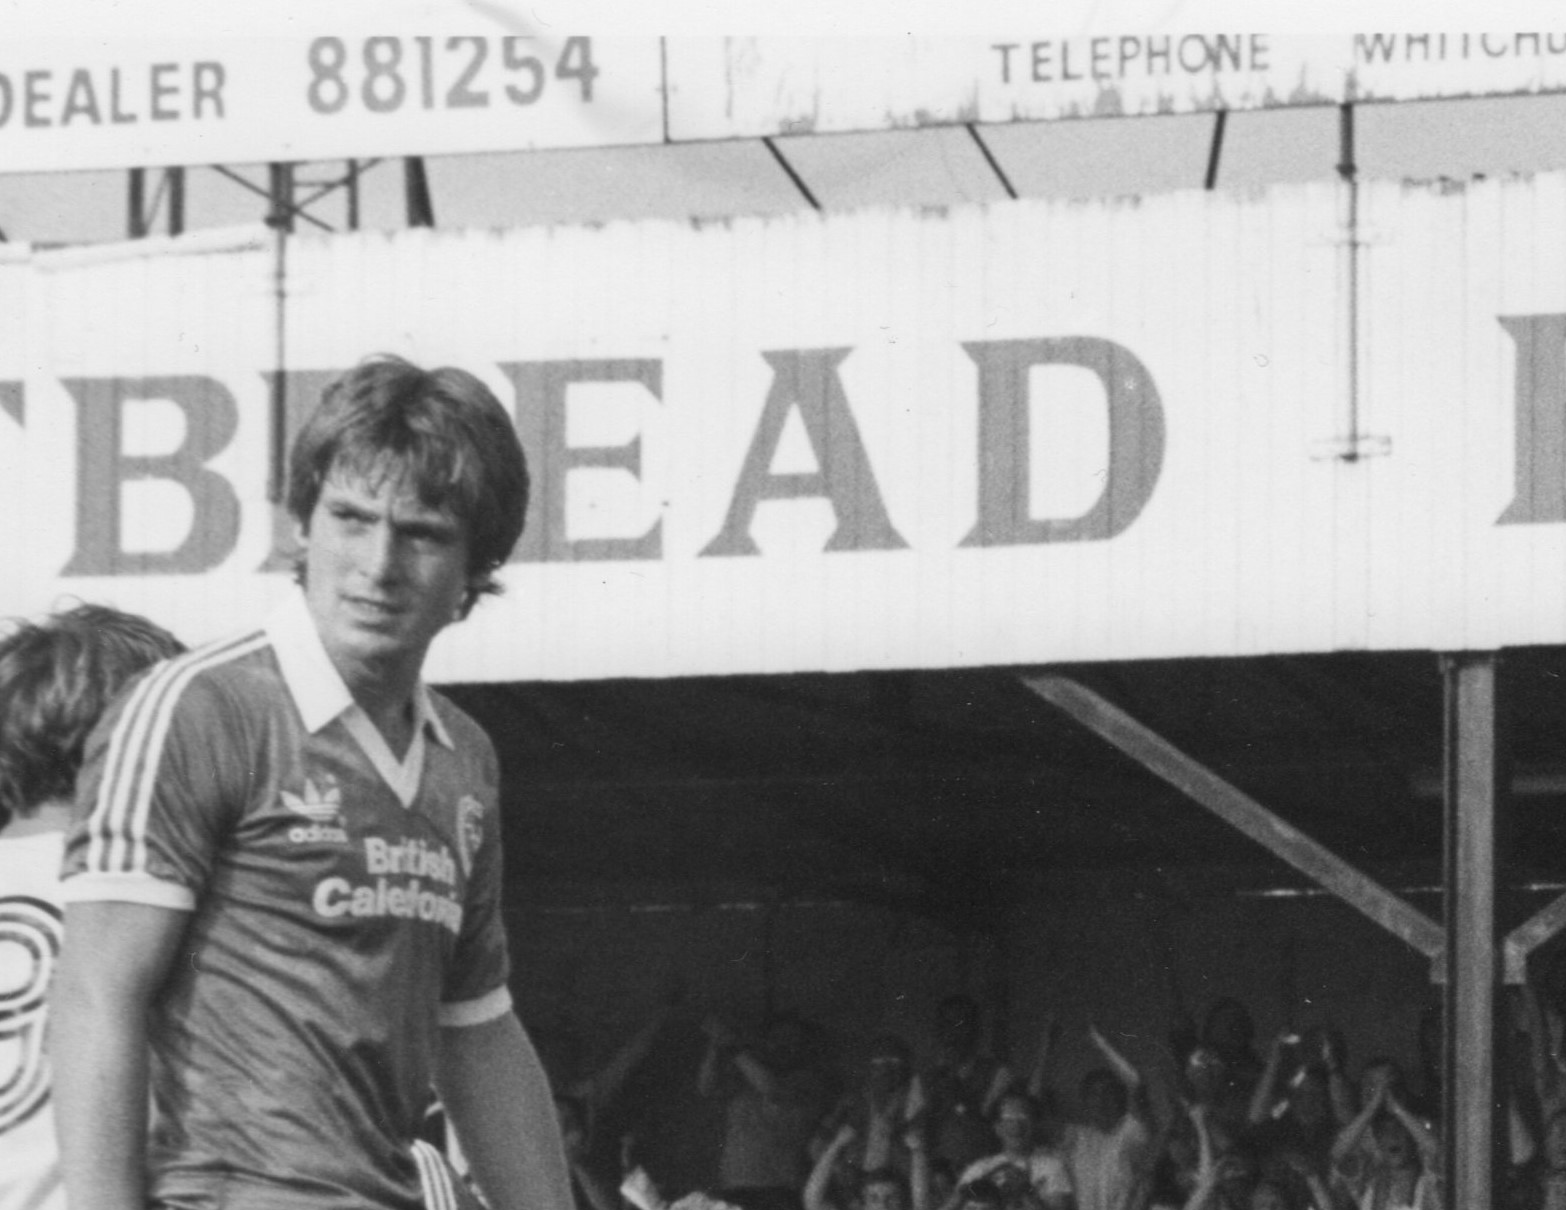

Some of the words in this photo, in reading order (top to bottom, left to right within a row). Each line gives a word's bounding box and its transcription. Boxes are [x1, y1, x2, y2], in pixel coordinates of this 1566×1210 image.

[307, 35, 599, 115] 881254
[991, 33, 1271, 84] TELEPHONE
[0, 336, 1166, 577] BEAD
